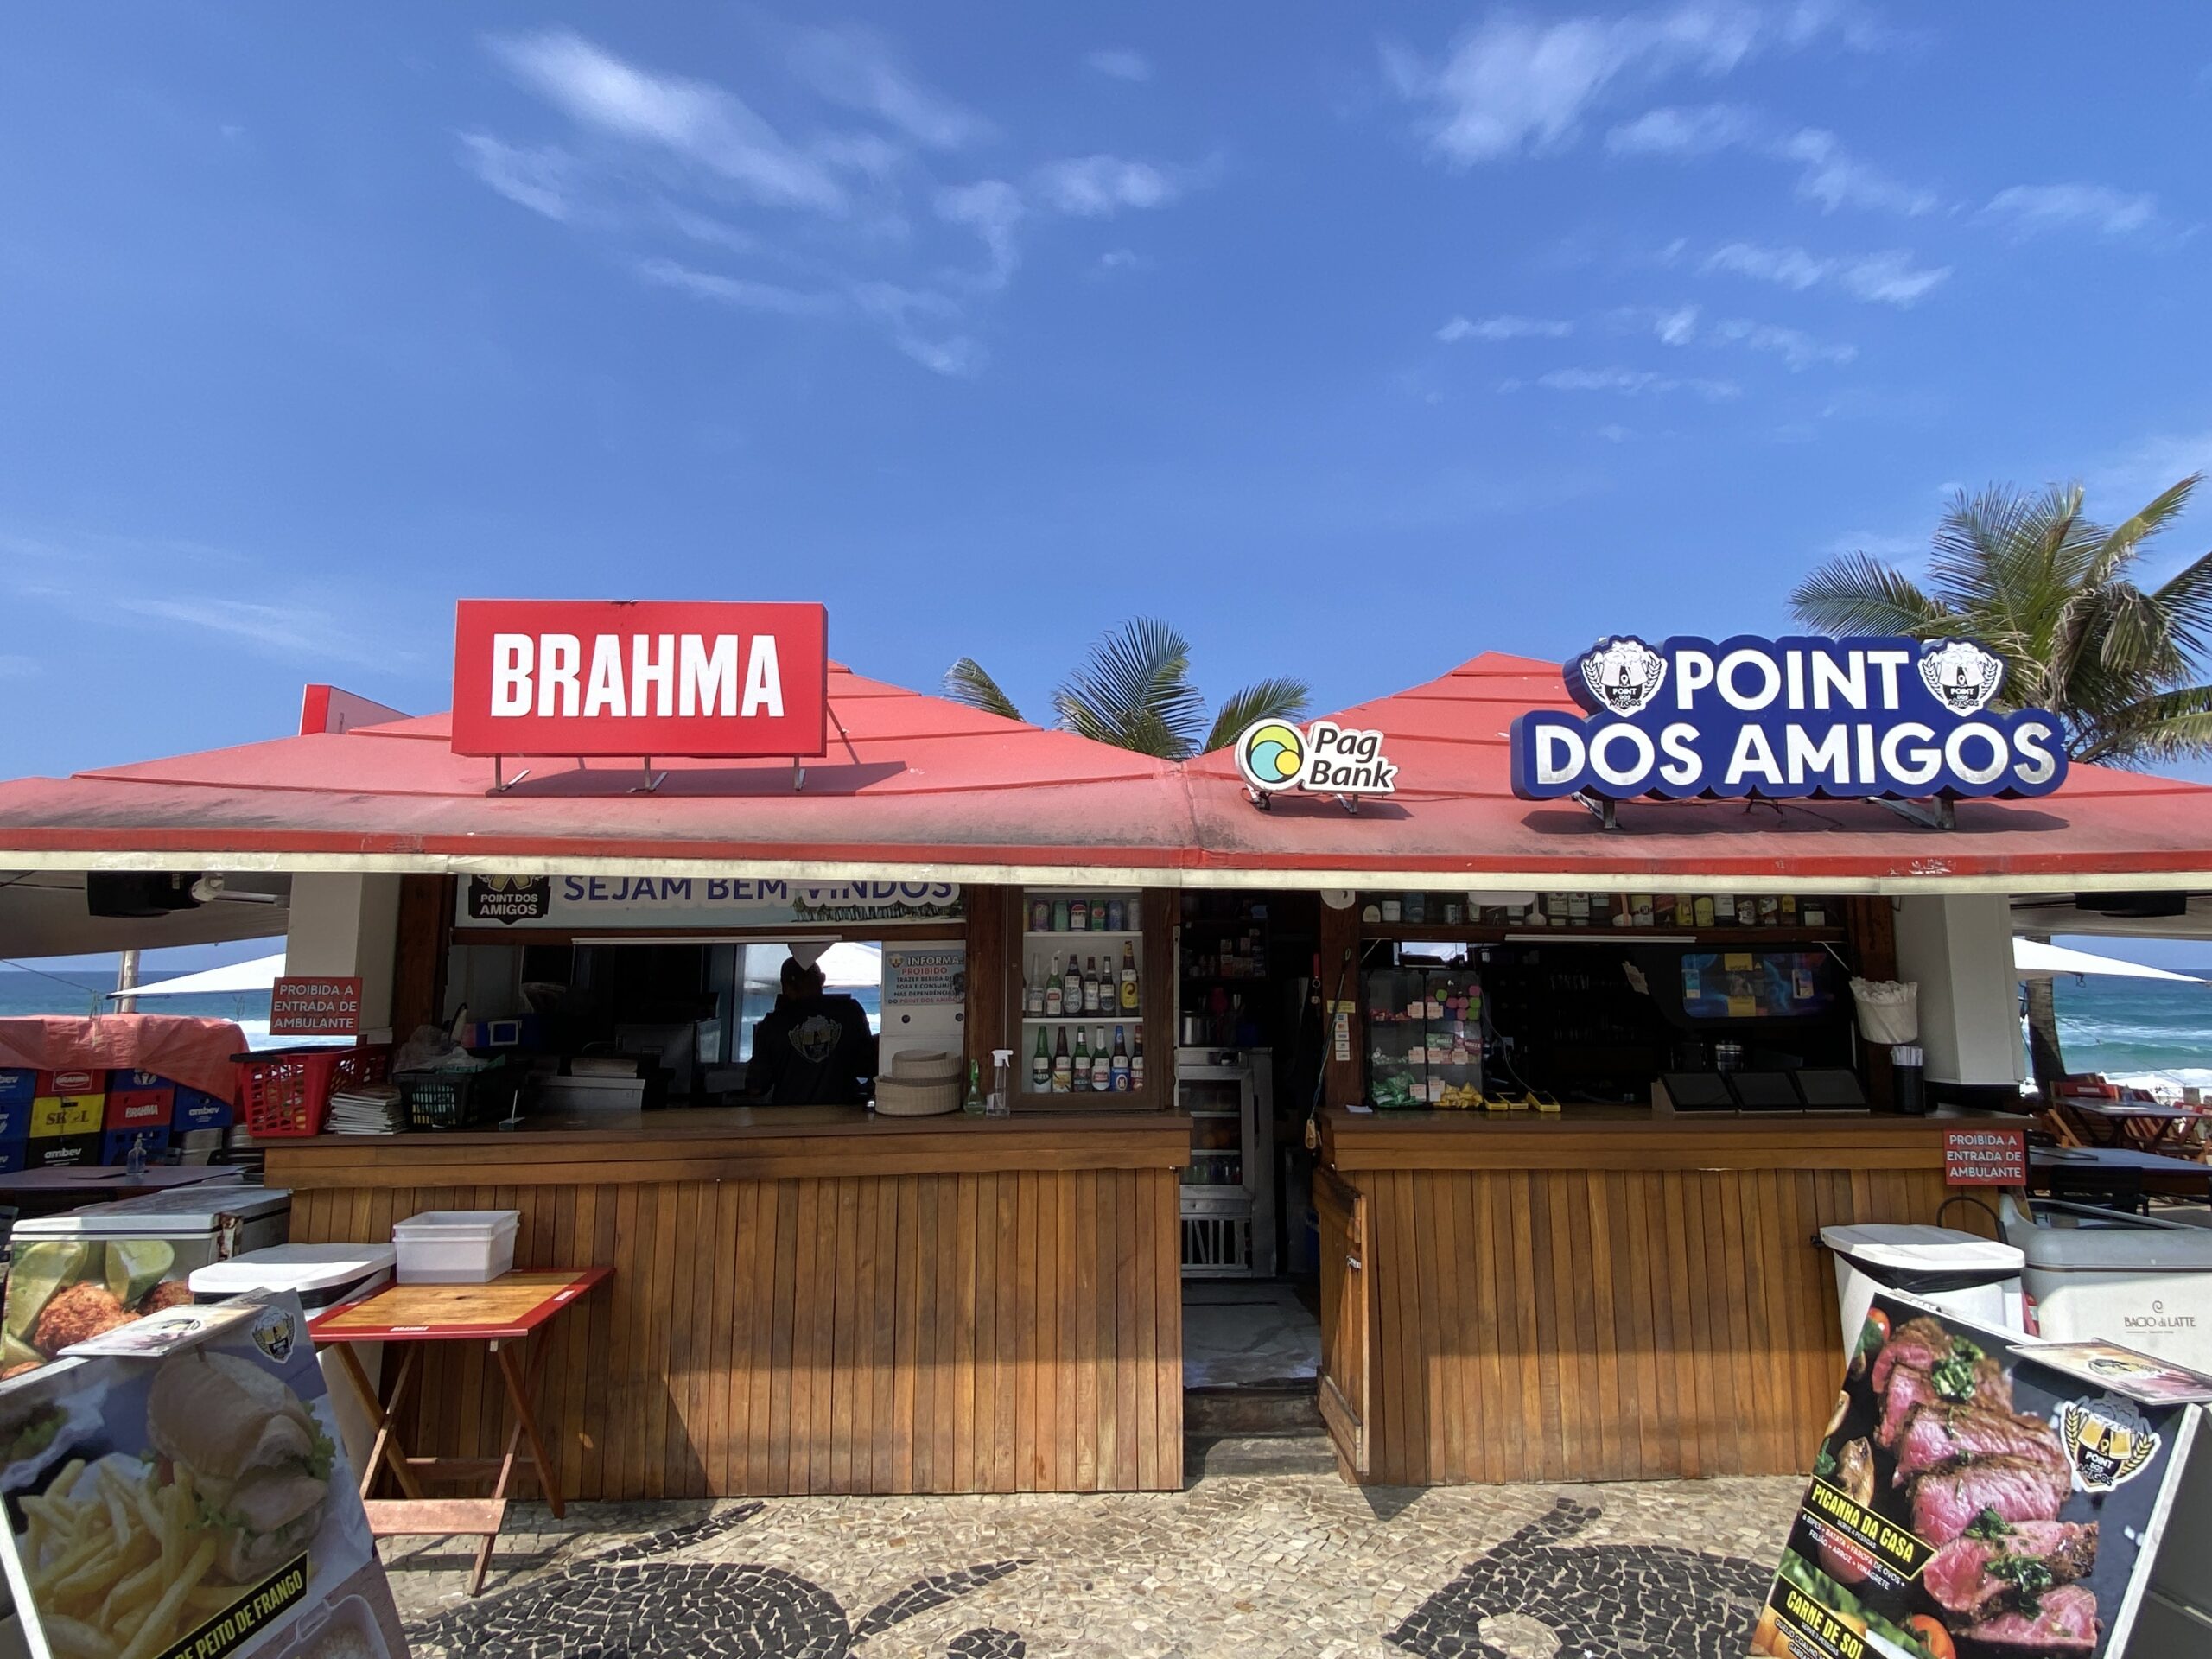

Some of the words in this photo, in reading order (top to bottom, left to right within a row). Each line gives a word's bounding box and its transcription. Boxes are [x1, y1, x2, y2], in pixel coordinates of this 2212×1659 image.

[491, 632, 785, 718] BRAHMA
[1675, 649, 1910, 710] POINT
[1609, 698, 1642, 707] AMIGOS
[1948, 698, 1980, 707] AMIGOS
[1314, 728, 1379, 764] Pag
[1535, 722, 1703, 786] DOS
[1724, 722, 2056, 786] AMIGOS
[1309, 760, 1394, 789] Bank
[563, 876, 691, 901] SEJAM
[706, 878, 787, 900] BEM
[480, 894, 512, 903] POINT
[480, 904, 537, 916] AMIGOS
[280, 985, 340, 995] PROIBIDA
[344, 985, 353, 995] A
[274, 1001, 335, 1012] ENTRADA
[340, 1001, 358, 1012] DE
[274, 1018, 354, 1028] AMBULANTE
[125, 1104, 158, 1118] BRAHMA
[188, 1106, 220, 1116] ambev
[1949, 1135, 2005, 1146] PROIBIDA
[2007, 1135, 2018, 1146] A
[44, 1147, 82, 1159] ambev
[1946, 1150, 2003, 1161] ENTRADA
[2005, 1151, 2022, 1161] DE
[1949, 1166, 2022, 1178] AMBULANTE
[2124, 1316, 2157, 1327] BACIO
[2168, 1316, 2196, 1327] LATTE
[2085, 1451, 2114, 1469] POINT
[2089, 1462, 2104, 1474] DOS
[1811, 1484, 1861, 1529] PICANHA
[1860, 1515, 1880, 1540] DA
[1879, 1527, 1915, 1563] CASA
[1825, 1529, 1847, 1547] BATATA
[1850, 1546, 1873, 1566] FAROFA
[1872, 1561, 1882, 1572] DE
[1882, 1567, 1901, 1585] OVOS
[1832, 1546, 1853, 1564] ARROZ
[1856, 1561, 1891, 1591] VINAGRETE
[194, 1618, 236, 1659] PEITO
[234, 1604, 256, 1634] DE
[252, 1569, 302, 1620] FRANGO
[1786, 1590, 1824, 1631] CARNE
[1821, 1618, 1841, 1644] DE
[1775, 1618, 1795, 1639] QUEIJO
